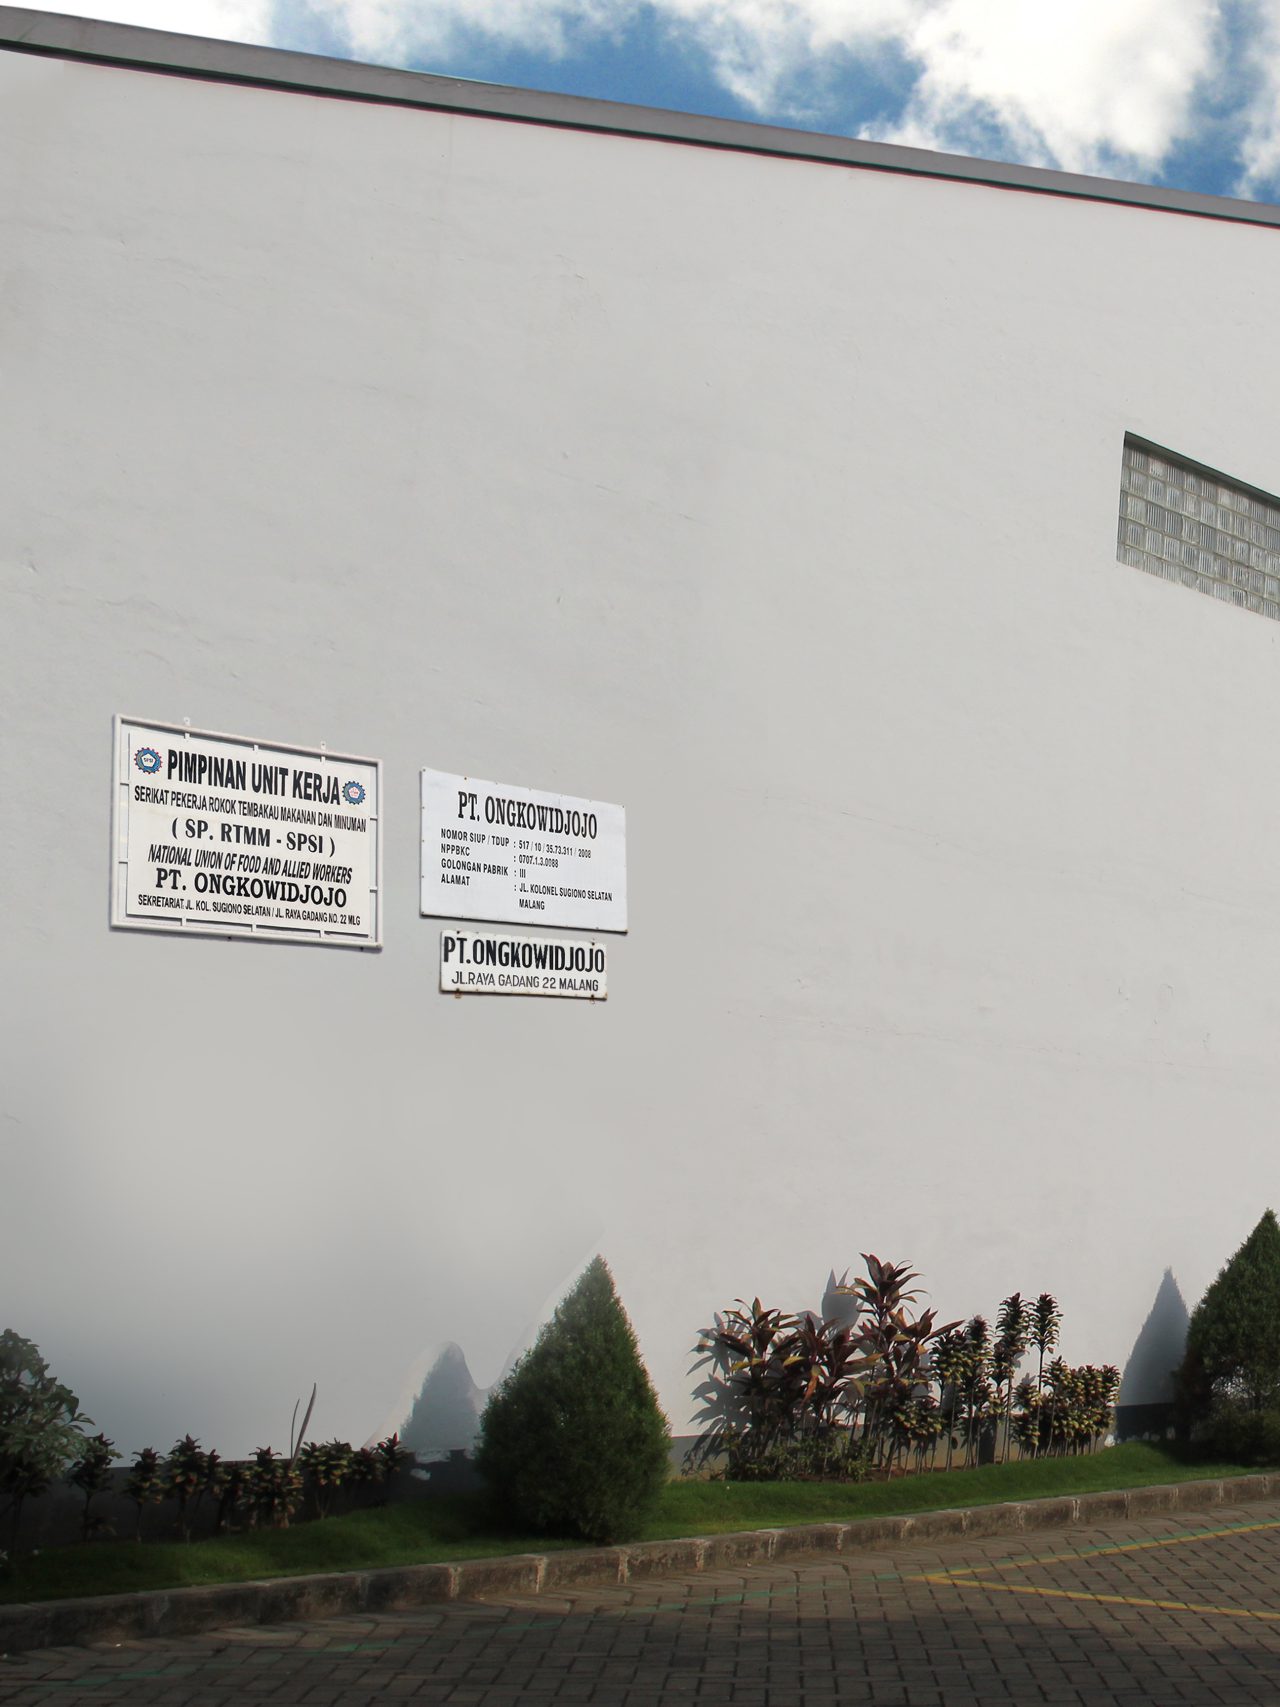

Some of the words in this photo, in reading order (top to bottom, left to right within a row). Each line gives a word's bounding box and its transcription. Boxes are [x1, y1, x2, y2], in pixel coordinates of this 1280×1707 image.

[167, 748, 246, 791] PIMPINAN
[251, 762, 289, 797] UNIT
[292, 769, 341, 805] KERJA
[134, 785, 170, 806] SERIKAT
[170, 791, 208, 811] PEKERJA
[208, 796, 237, 815] ROKOK
[238, 800, 280, 821] TEMBAKAU
[280, 806, 317, 826] MAKANAN
[317, 812, 334, 828] DAN
[334, 814, 367, 833] MINUMAN
[458, 790, 481, 822] PT.
[484, 795, 598, 840] ONGKOWIDJOJO
[185, 818, 214, 840] SP.
[220, 823, 271, 848] RTMM
[286, 831, 323, 854] SPSI
[440, 828, 468, 842] NOMOR
[469, 832, 487, 844] SIUP
[491, 835, 510, 847] TDUP
[440, 843, 471, 857] NPPBKC
[518, 840, 530, 850] 517
[534, 842, 542, 852] 10
[147, 844, 193, 867] NATIONAL
[194, 849, 224, 870] UNION
[224, 852, 238, 871] OF
[237, 853, 262, 874] FOOD
[261, 857, 281, 876] AND
[281, 859, 311, 880] ALLIED
[312, 862, 353, 885] WORKERS
[441, 858, 482, 872] GOLONGAN
[483, 863, 509, 876] PABRIK
[155, 867, 187, 891] PT.
[194, 872, 347, 908] ONGKOWIDJOJO
[440, 873, 471, 886] ALAMAT
[519, 882, 529, 893] JL.
[529, 883, 559, 897] KOLONEL
[559, 887, 587, 899] SUGIONO
[587, 890, 613, 901] SELATAN
[185, 899, 195, 911] JL.
[195, 900, 212, 912] KOL.
[212, 901, 243, 915] SUGIONO
[243, 904, 271, 918] SELATAN
[274, 907, 285, 919] JL.
[285, 908, 302, 921] RAYA
[301, 910, 329, 923] GADANG
[340, 914, 348, 925] 22
[348, 915, 361, 926] MLG
[519, 898, 546, 911] MALANG
[498, 973, 540, 988] GADANG
[542, 976, 556, 989] 22
[559, 977, 599, 992] MALANG
